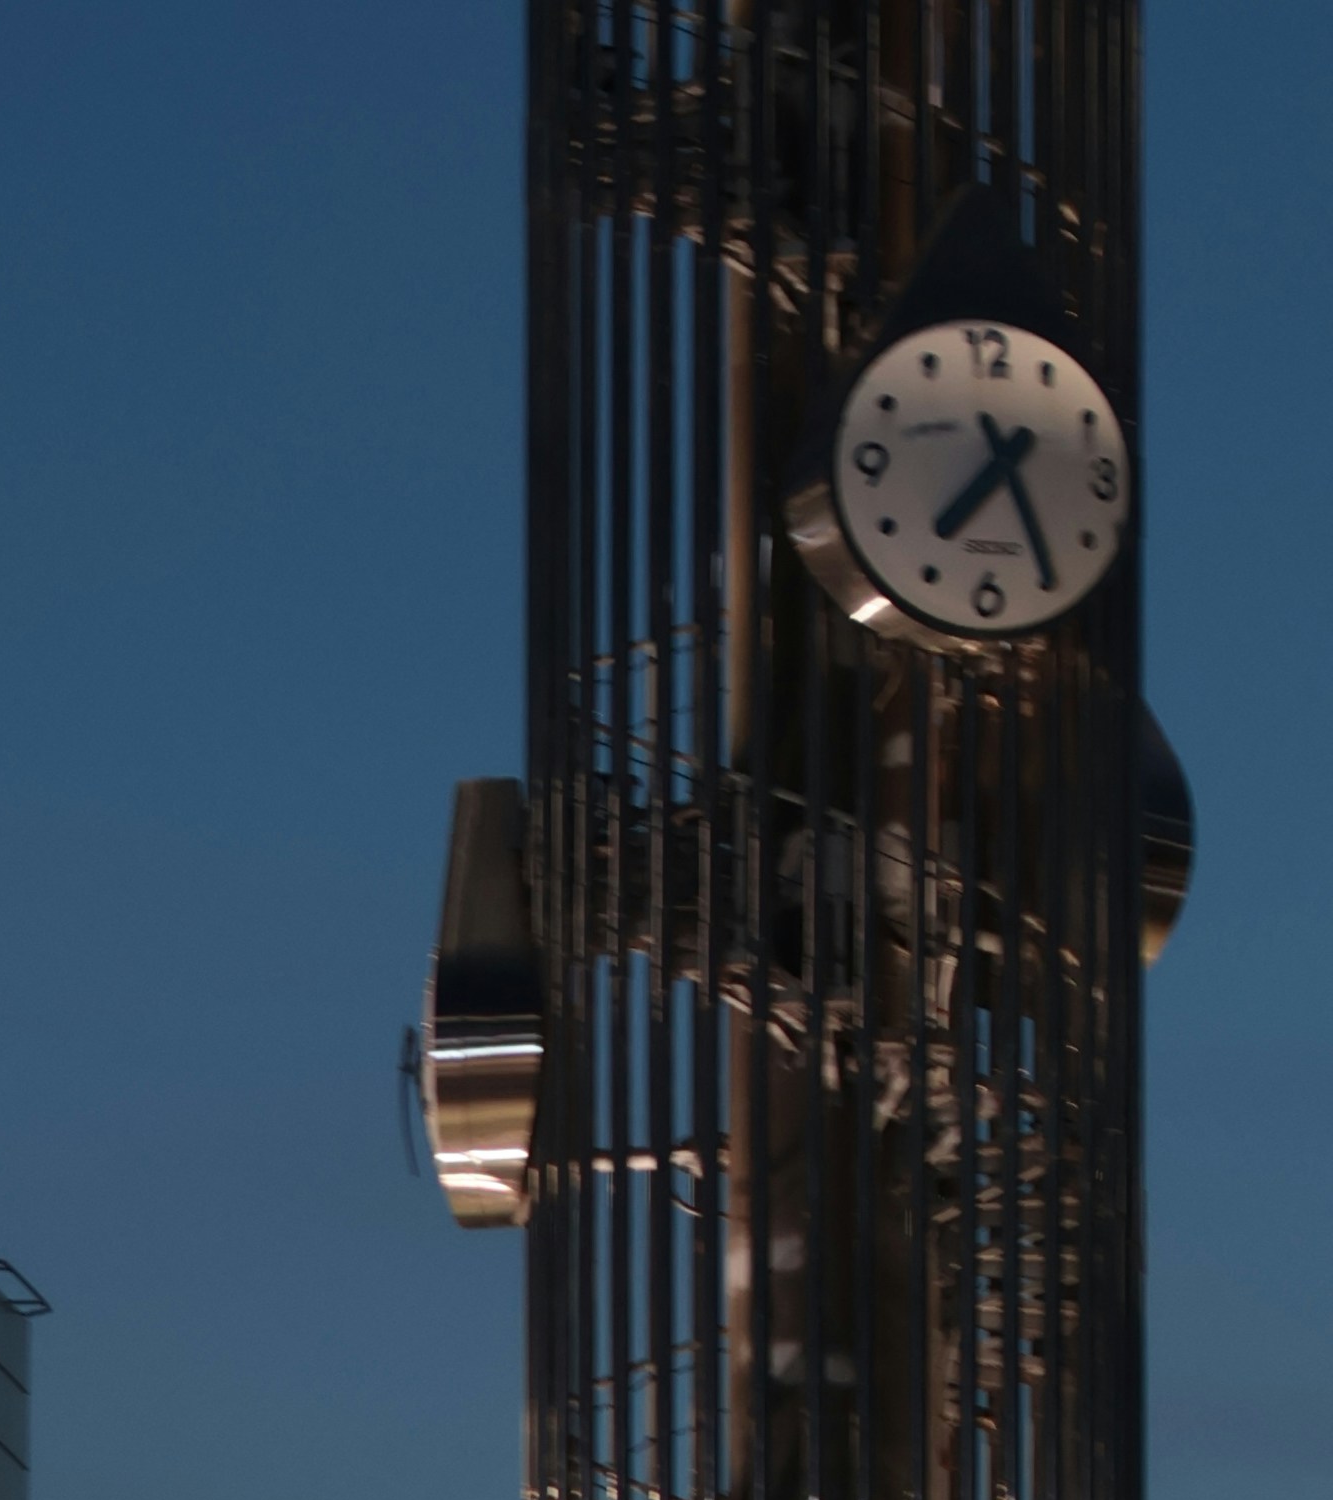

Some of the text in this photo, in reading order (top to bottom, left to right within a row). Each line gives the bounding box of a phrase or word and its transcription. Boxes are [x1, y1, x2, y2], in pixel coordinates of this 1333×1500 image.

[965, 327, 1012, 380] 12
[854, 440, 890, 487] 9
[1090, 457, 1118, 501] 3
[972, 571, 1007, 617] 6
